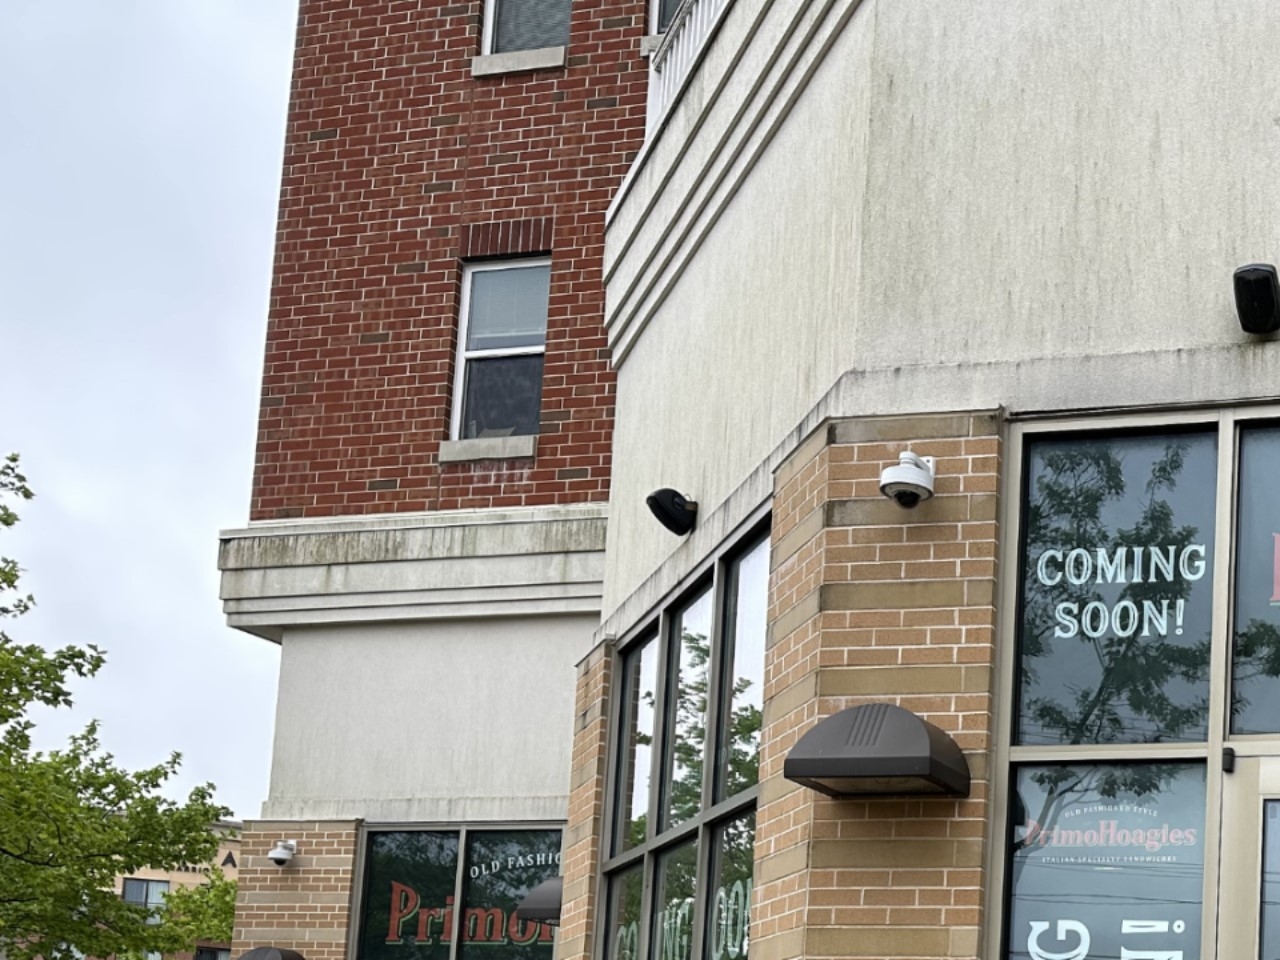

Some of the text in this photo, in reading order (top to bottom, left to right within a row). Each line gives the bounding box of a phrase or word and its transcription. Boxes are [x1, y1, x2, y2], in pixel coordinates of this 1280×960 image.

[1036, 544, 1206, 586] COMING
[1054, 599, 1185, 638] SOON!
[1024, 819, 1197, 852] PrimoHoagies
[470, 860, 500, 879] OLD
